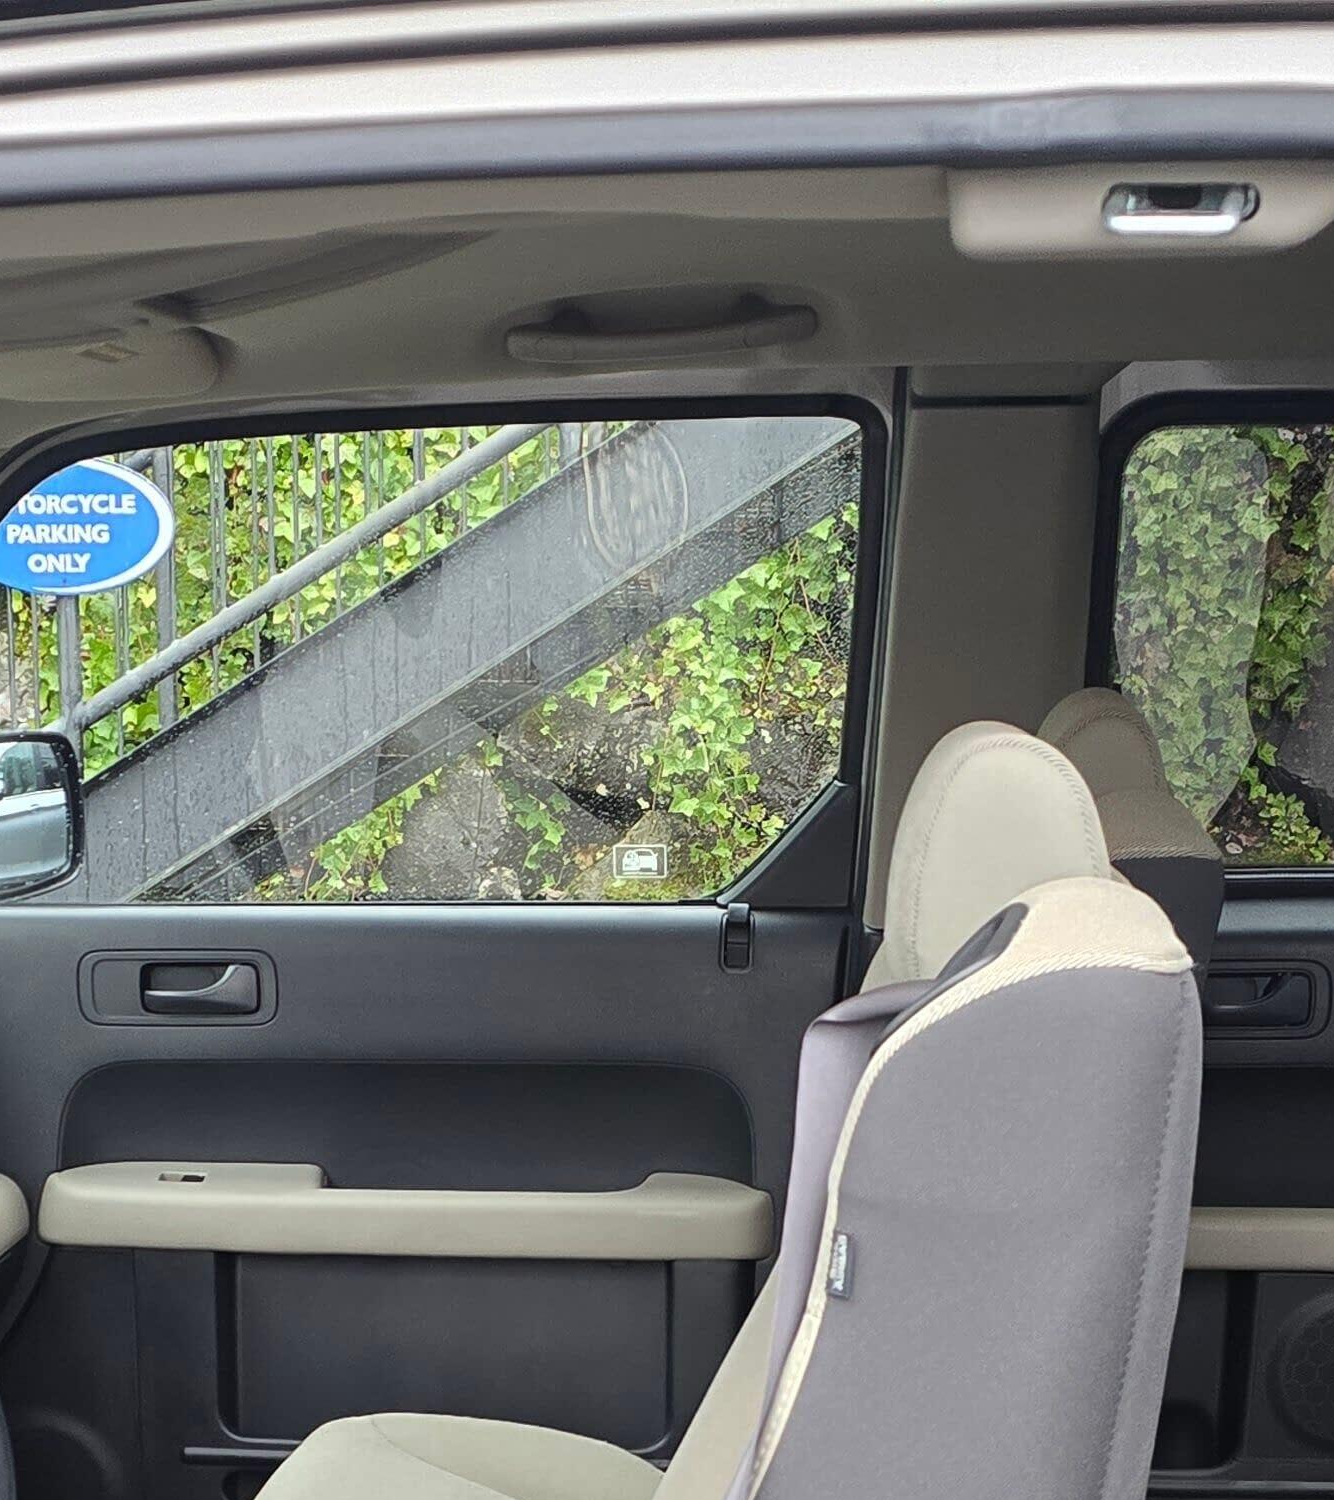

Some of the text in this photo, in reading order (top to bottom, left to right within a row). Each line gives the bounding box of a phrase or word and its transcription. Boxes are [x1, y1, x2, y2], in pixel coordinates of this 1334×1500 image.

[16, 493, 137, 515] TORCYCLE
[7, 523, 111, 544] PARKING
[27, 553, 91, 573] ONLY
